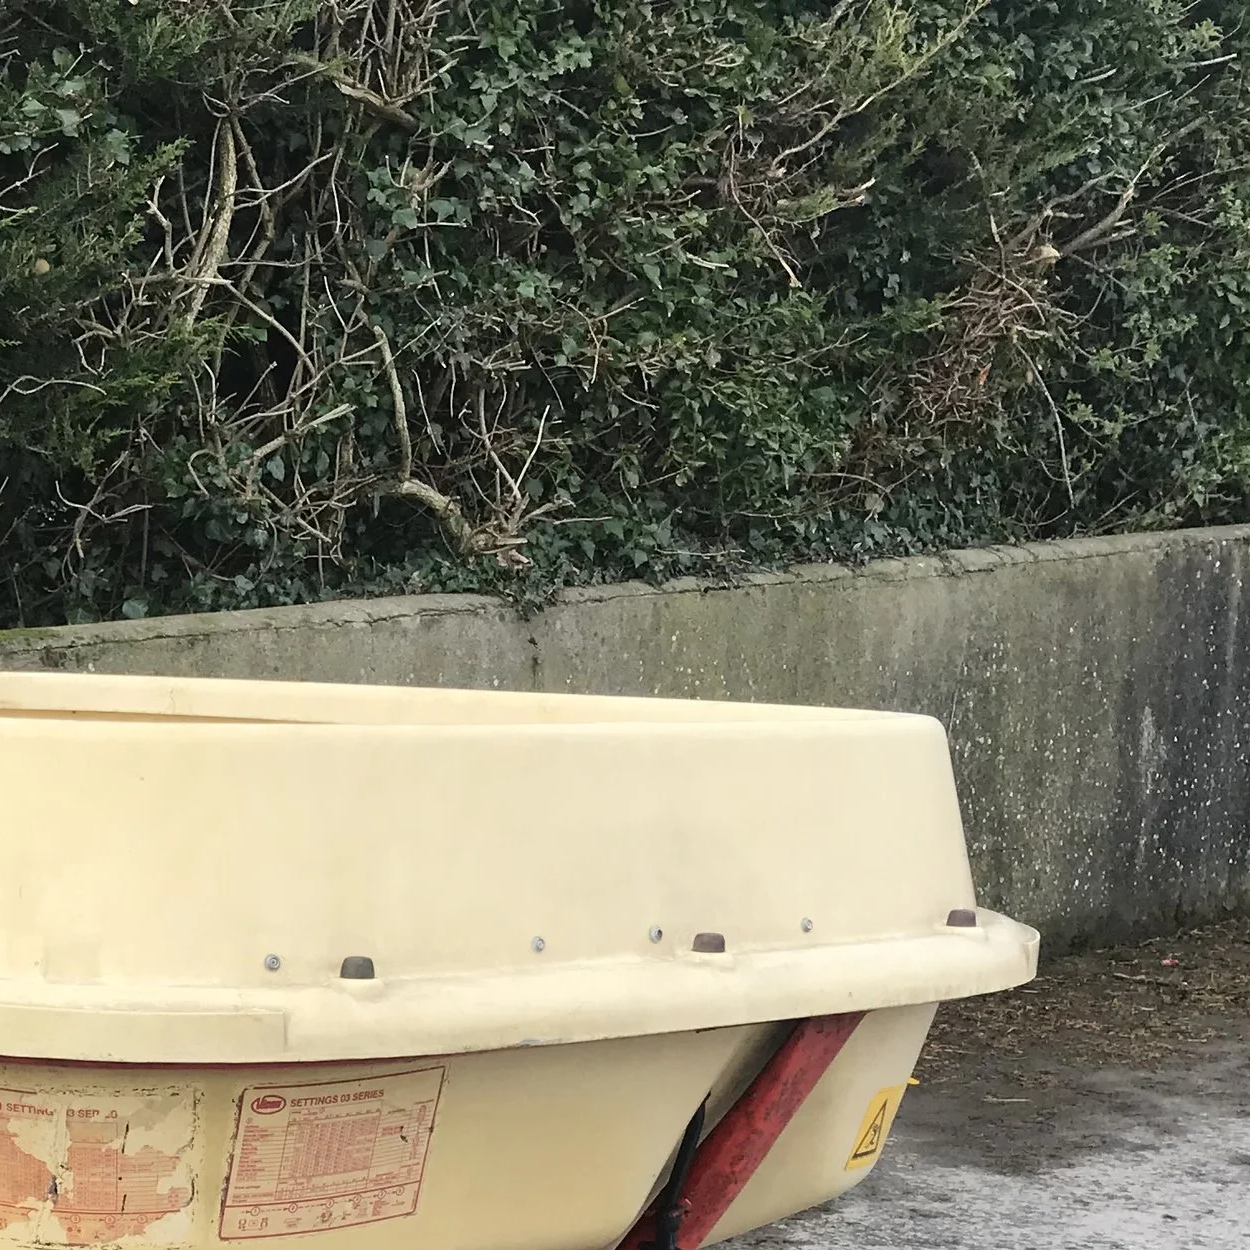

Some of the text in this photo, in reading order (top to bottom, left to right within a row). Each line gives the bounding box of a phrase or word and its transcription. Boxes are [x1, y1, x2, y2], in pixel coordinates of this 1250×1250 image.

[290, 1096, 338, 1108] SETTINGS
[340, 1093, 351, 1103] 03
[352, 1089, 385, 1101] SERIES
[6, 1103, 55, 1116] SETTING
